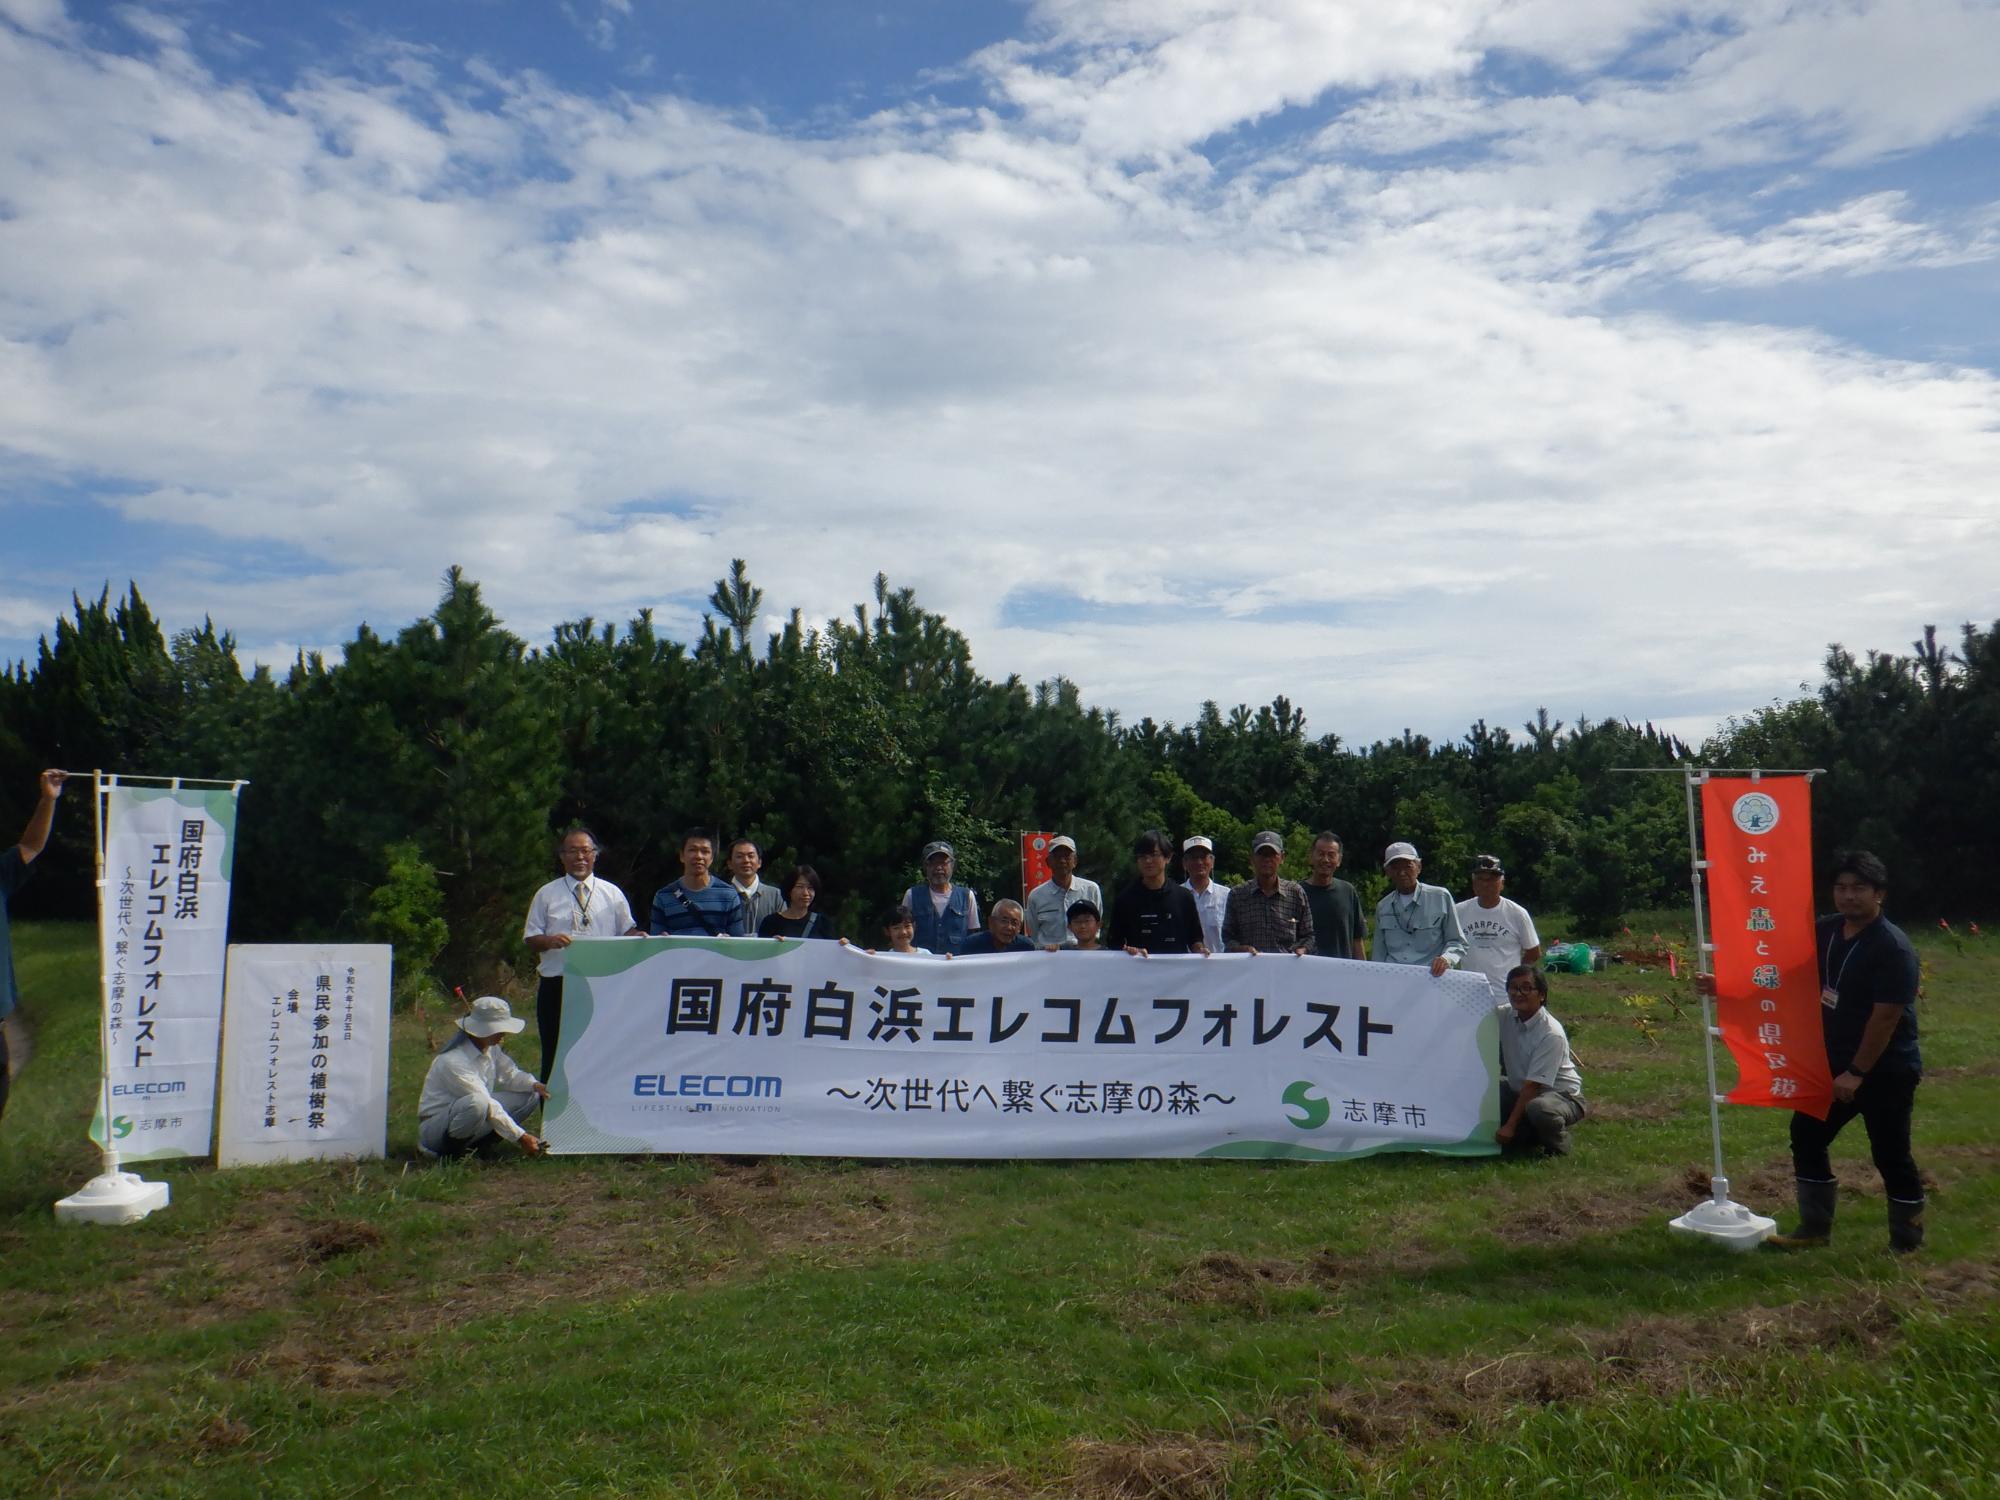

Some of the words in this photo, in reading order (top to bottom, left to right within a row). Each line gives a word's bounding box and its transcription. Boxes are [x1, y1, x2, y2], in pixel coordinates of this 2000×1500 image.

[174, 819, 204, 920] 国府白浜
[1463, 920, 1510, 937] SHARPEYE
[135, 844, 171, 1067] エレコムフォレスト
[287, 988, 300, 1013] 会場
[343, 966, 355, 1041] 令和六年十月五日
[666, 977, 1394, 1057] 国府白浜エレコムフォレスト
[308, 975, 332, 1129] 県民参加の植樹祭
[112, 1081, 186, 1096] ELECOM
[633, 1074, 783, 1098] ELECOM
[716, 1104, 781, 1113] INNOVATION
[1342, 1098, 1427, 1129] 志摩市
[138, 1116, 184, 1131] 志摩市
